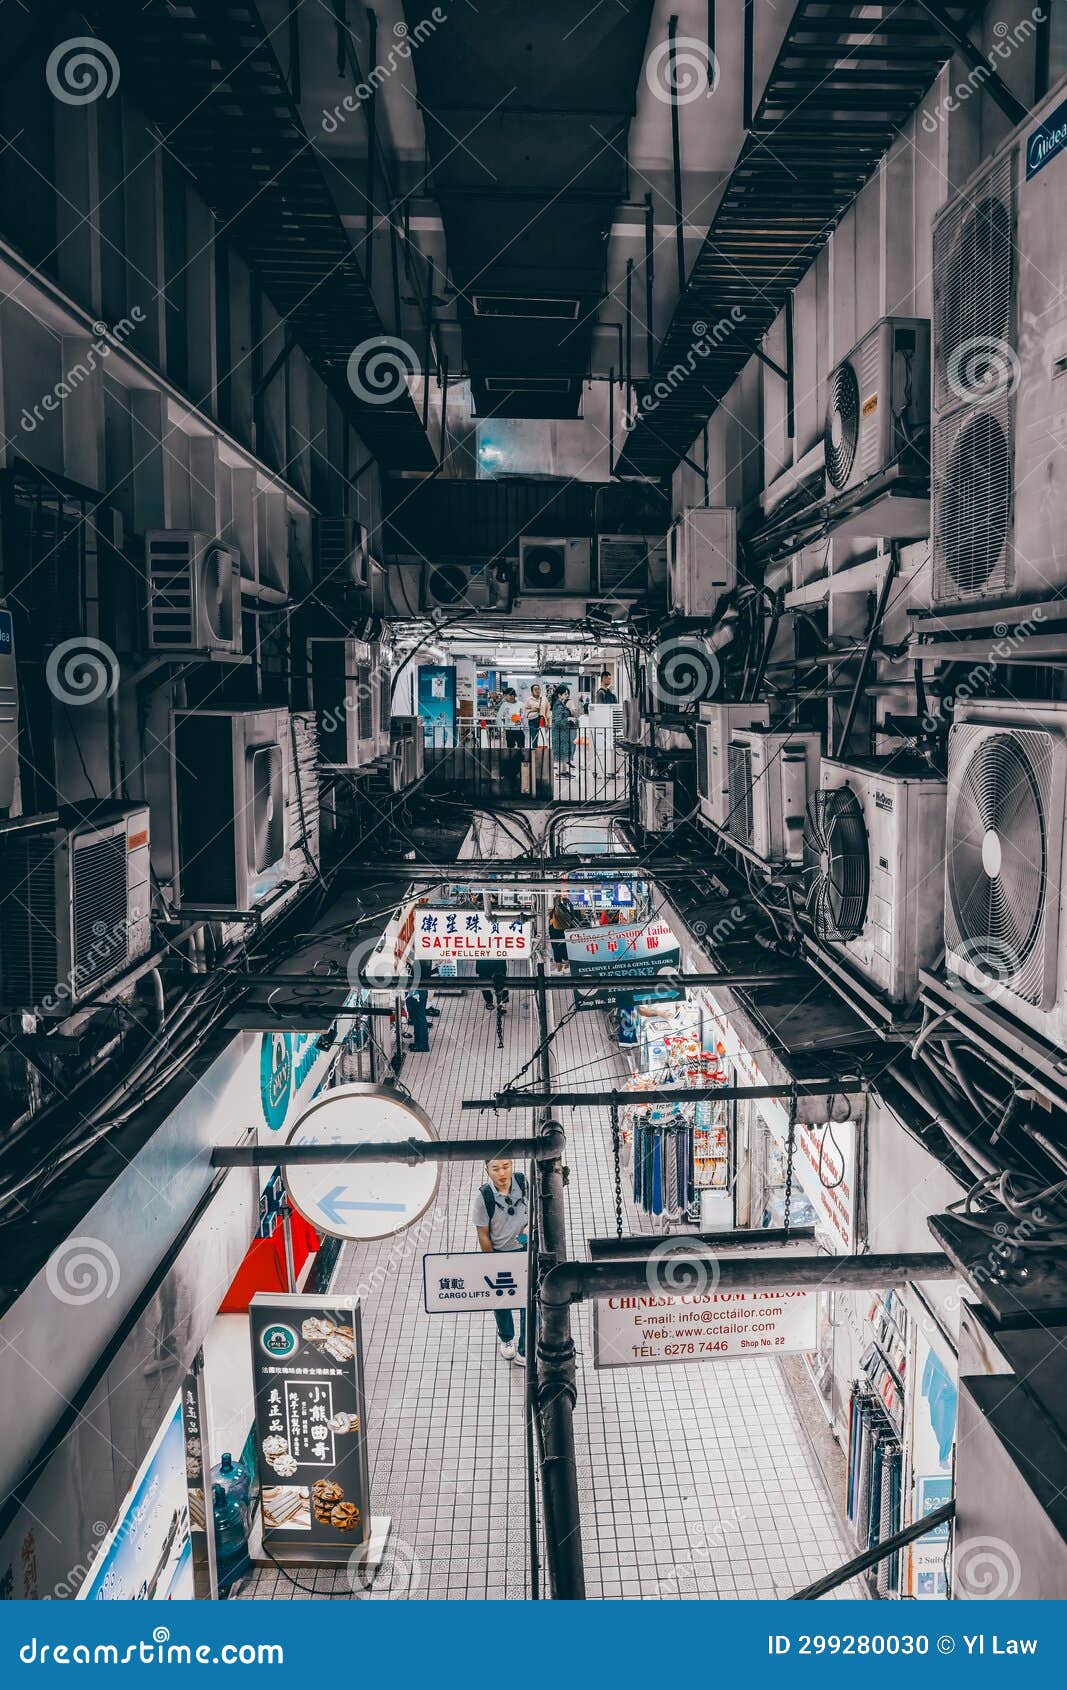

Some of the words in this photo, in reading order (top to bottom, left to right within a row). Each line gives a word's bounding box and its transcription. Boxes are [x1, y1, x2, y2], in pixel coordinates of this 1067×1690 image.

[422, 937, 526, 949] SATELLITES
[438, 1291, 468, 1300] CARGO
[468, 1290, 491, 1298] LIFTS
[634, 1313, 676, 1326] E-mail:
[678, 1306, 783, 1324] info@cctailor.com
[642, 1327, 672, 1340] Web:
[675, 1322, 776, 1338] www.cctailor.com
[632, 1346, 661, 1358] TEL:
[664, 1343, 695, 1356] 6278
[699, 1340, 729, 1353] 7446
[741, 1339, 760, 1349] Shop
[761, 1338, 773, 1346] No.
[775, 1337, 786, 1346] 22
[267, 1388, 284, 1432] 真正品
[308, 1386, 331, 1461] 小熊曲奇
